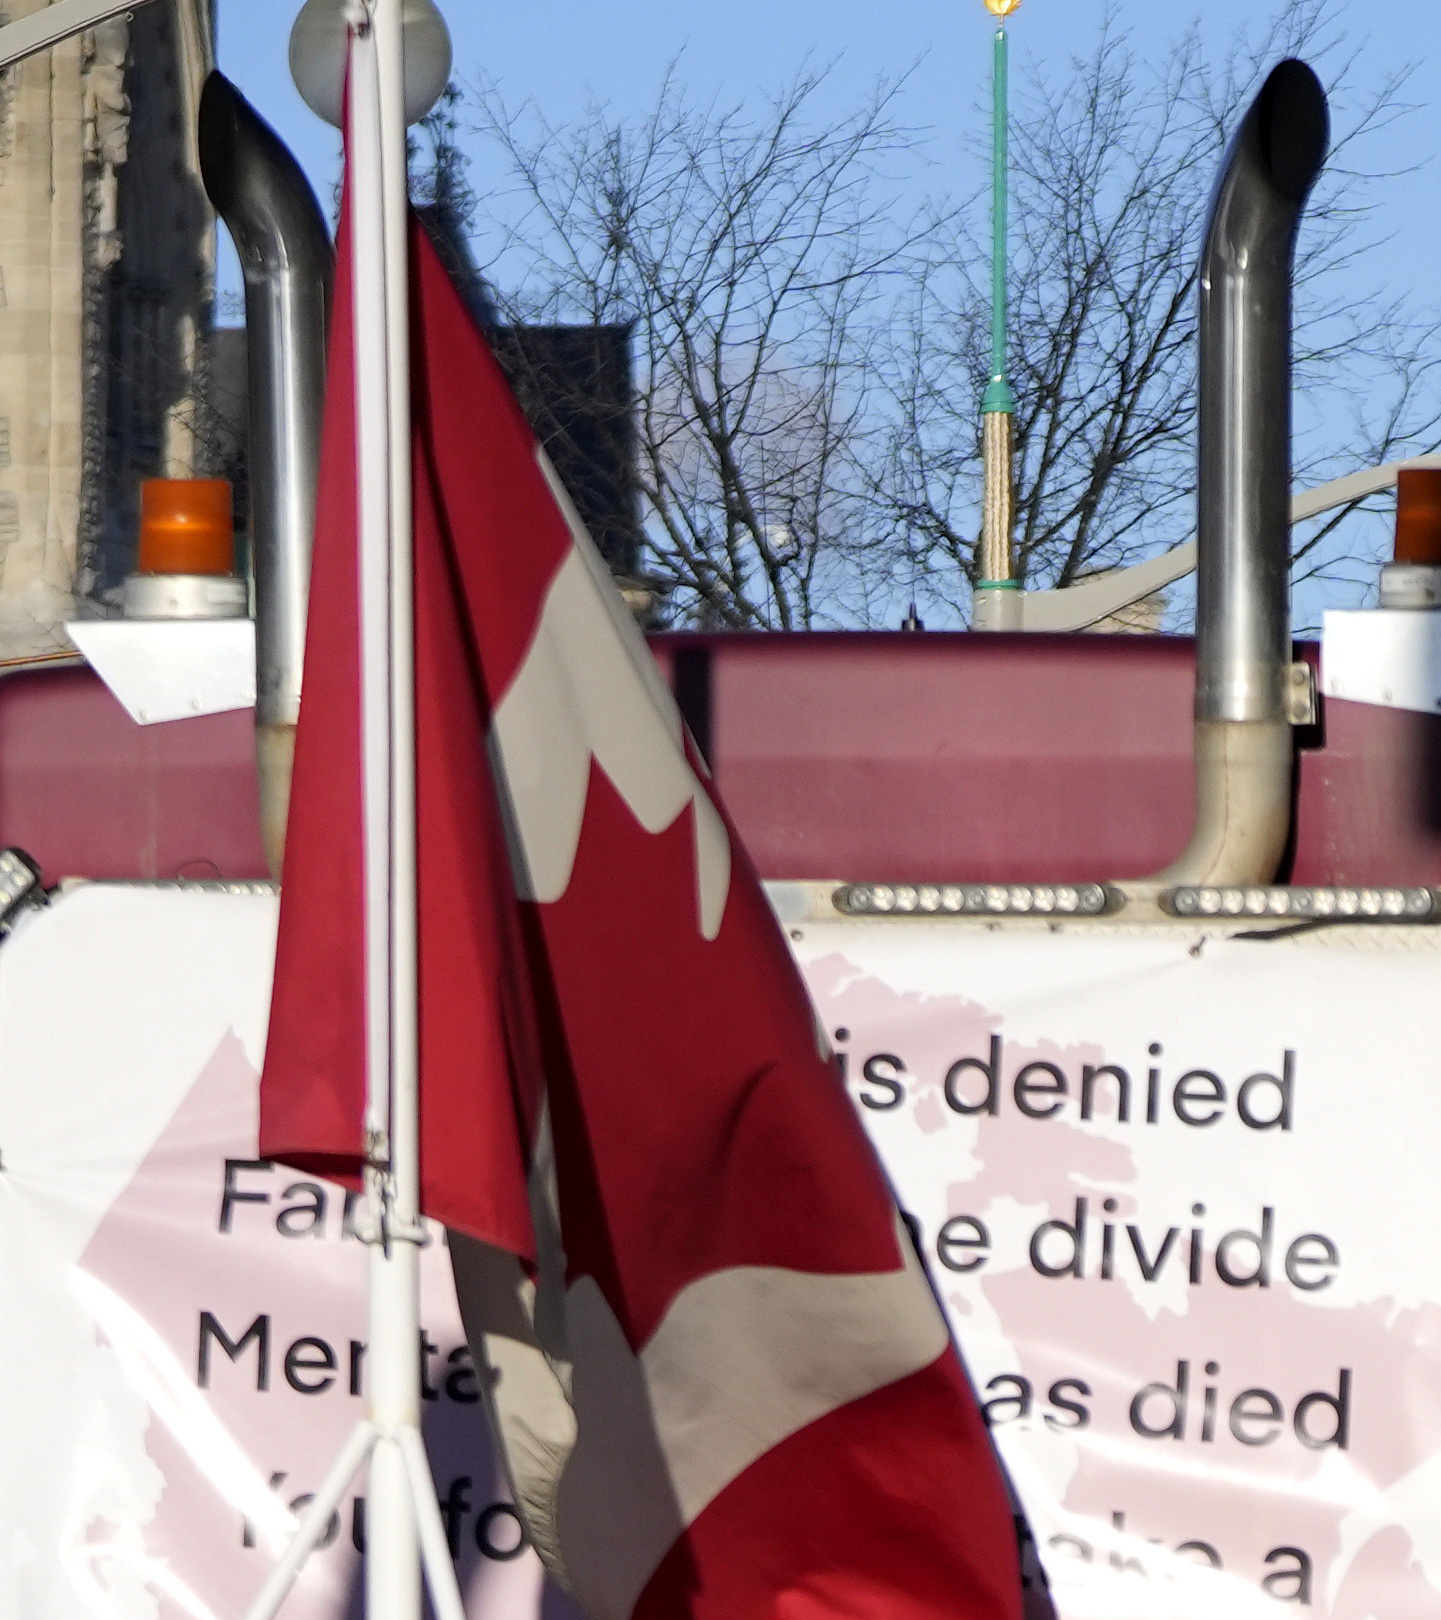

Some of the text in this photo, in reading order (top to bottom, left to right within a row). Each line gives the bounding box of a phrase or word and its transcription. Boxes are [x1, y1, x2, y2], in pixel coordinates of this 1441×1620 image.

[943, 1034, 1298, 1131] denied
[1029, 1196, 1342, 1292] divide
[1129, 1358, 1354, 1451] died
